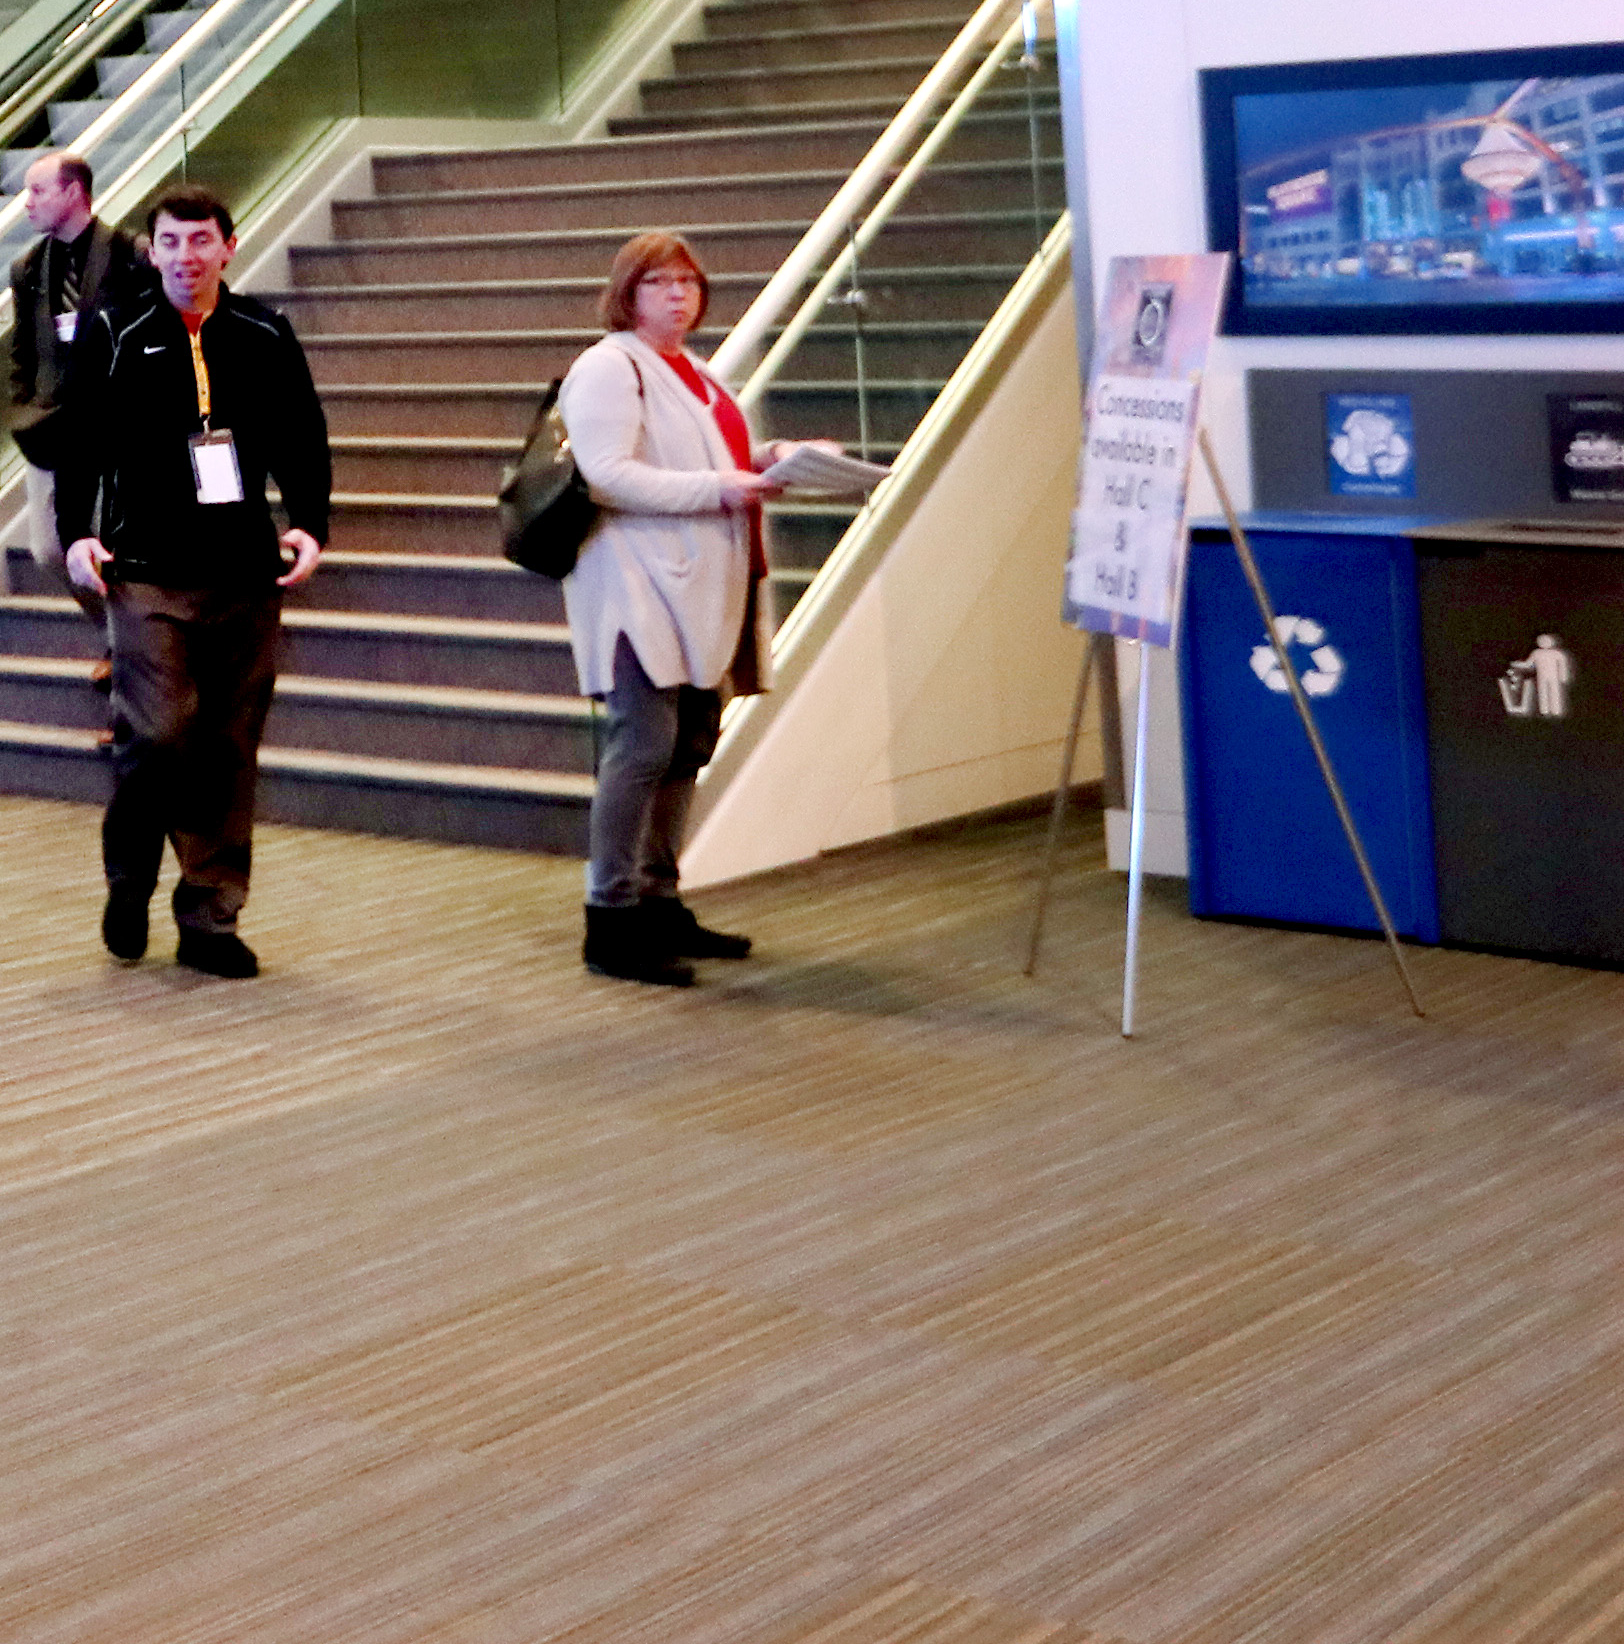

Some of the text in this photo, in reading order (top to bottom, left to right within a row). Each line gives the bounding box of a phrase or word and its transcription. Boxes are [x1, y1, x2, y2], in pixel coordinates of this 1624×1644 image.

[1096, 382, 1184, 423] Concessions
[1091, 428, 1176, 469] available in
